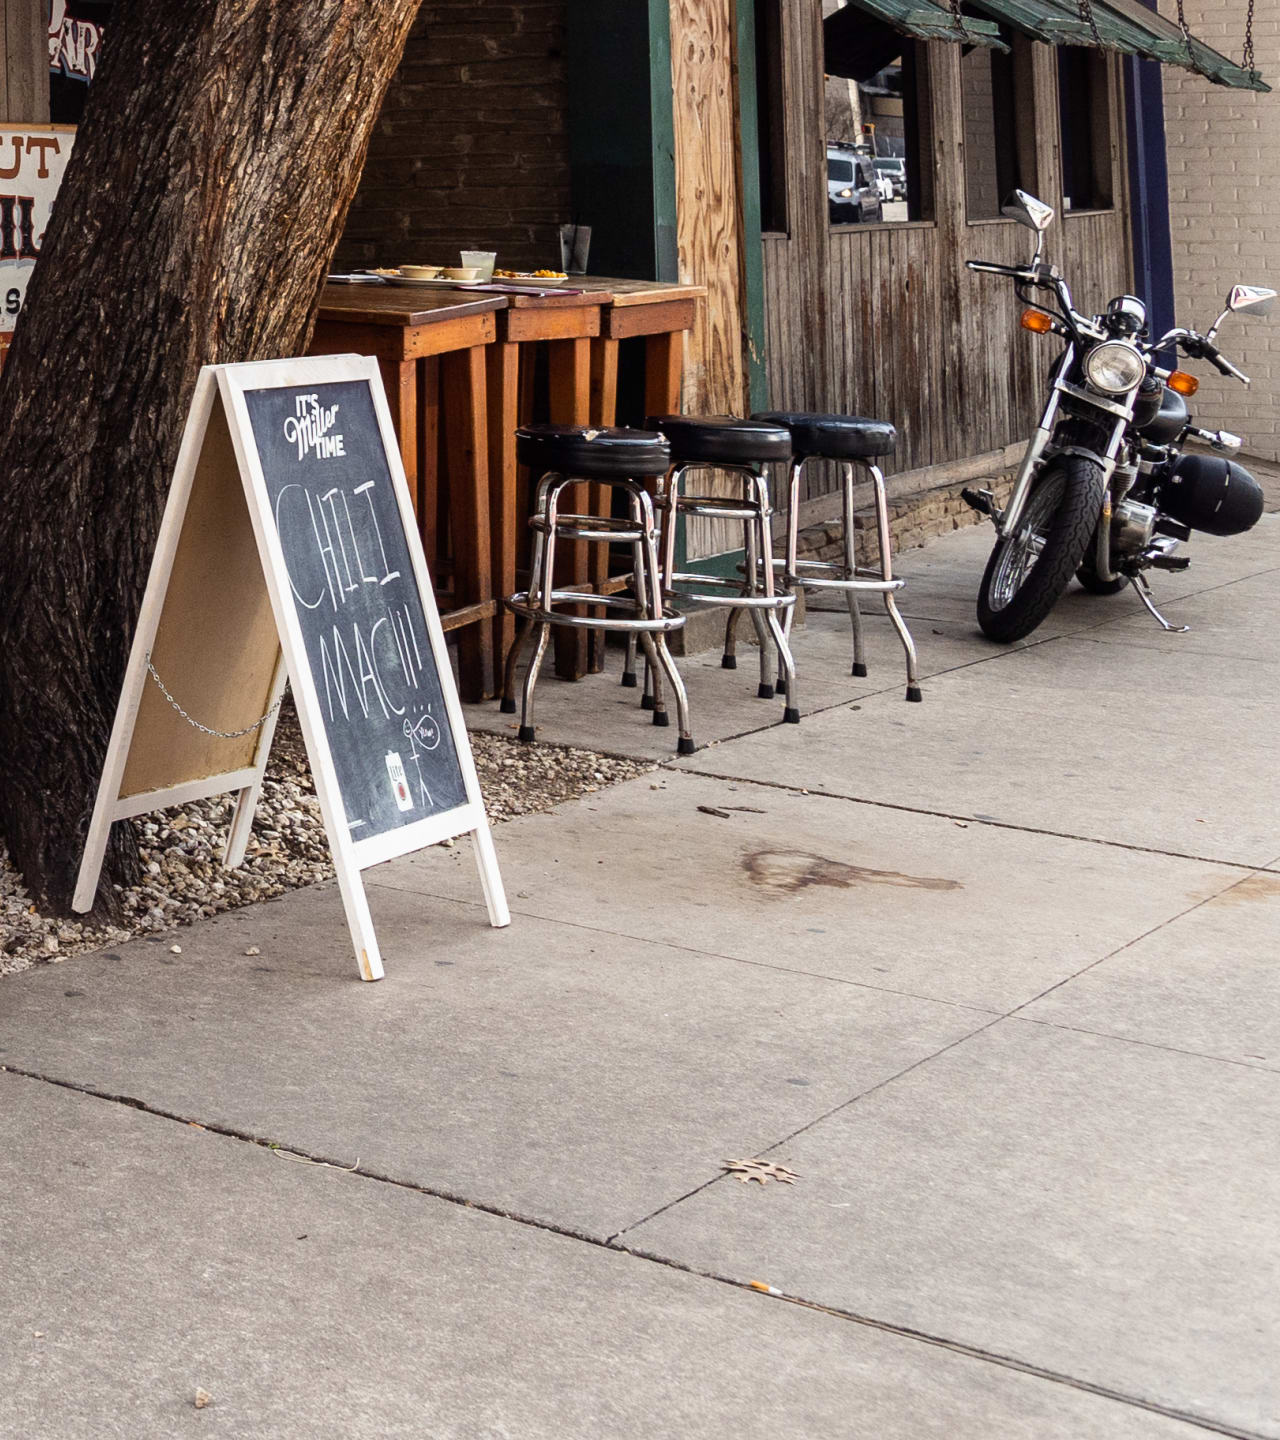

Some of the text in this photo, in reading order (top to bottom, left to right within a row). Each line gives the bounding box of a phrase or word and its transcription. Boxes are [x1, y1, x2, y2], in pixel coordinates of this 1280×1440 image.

[296, 393, 319, 417] IT'S
[283, 404, 340, 462] Miller
[316, 434, 347, 459] TIME
